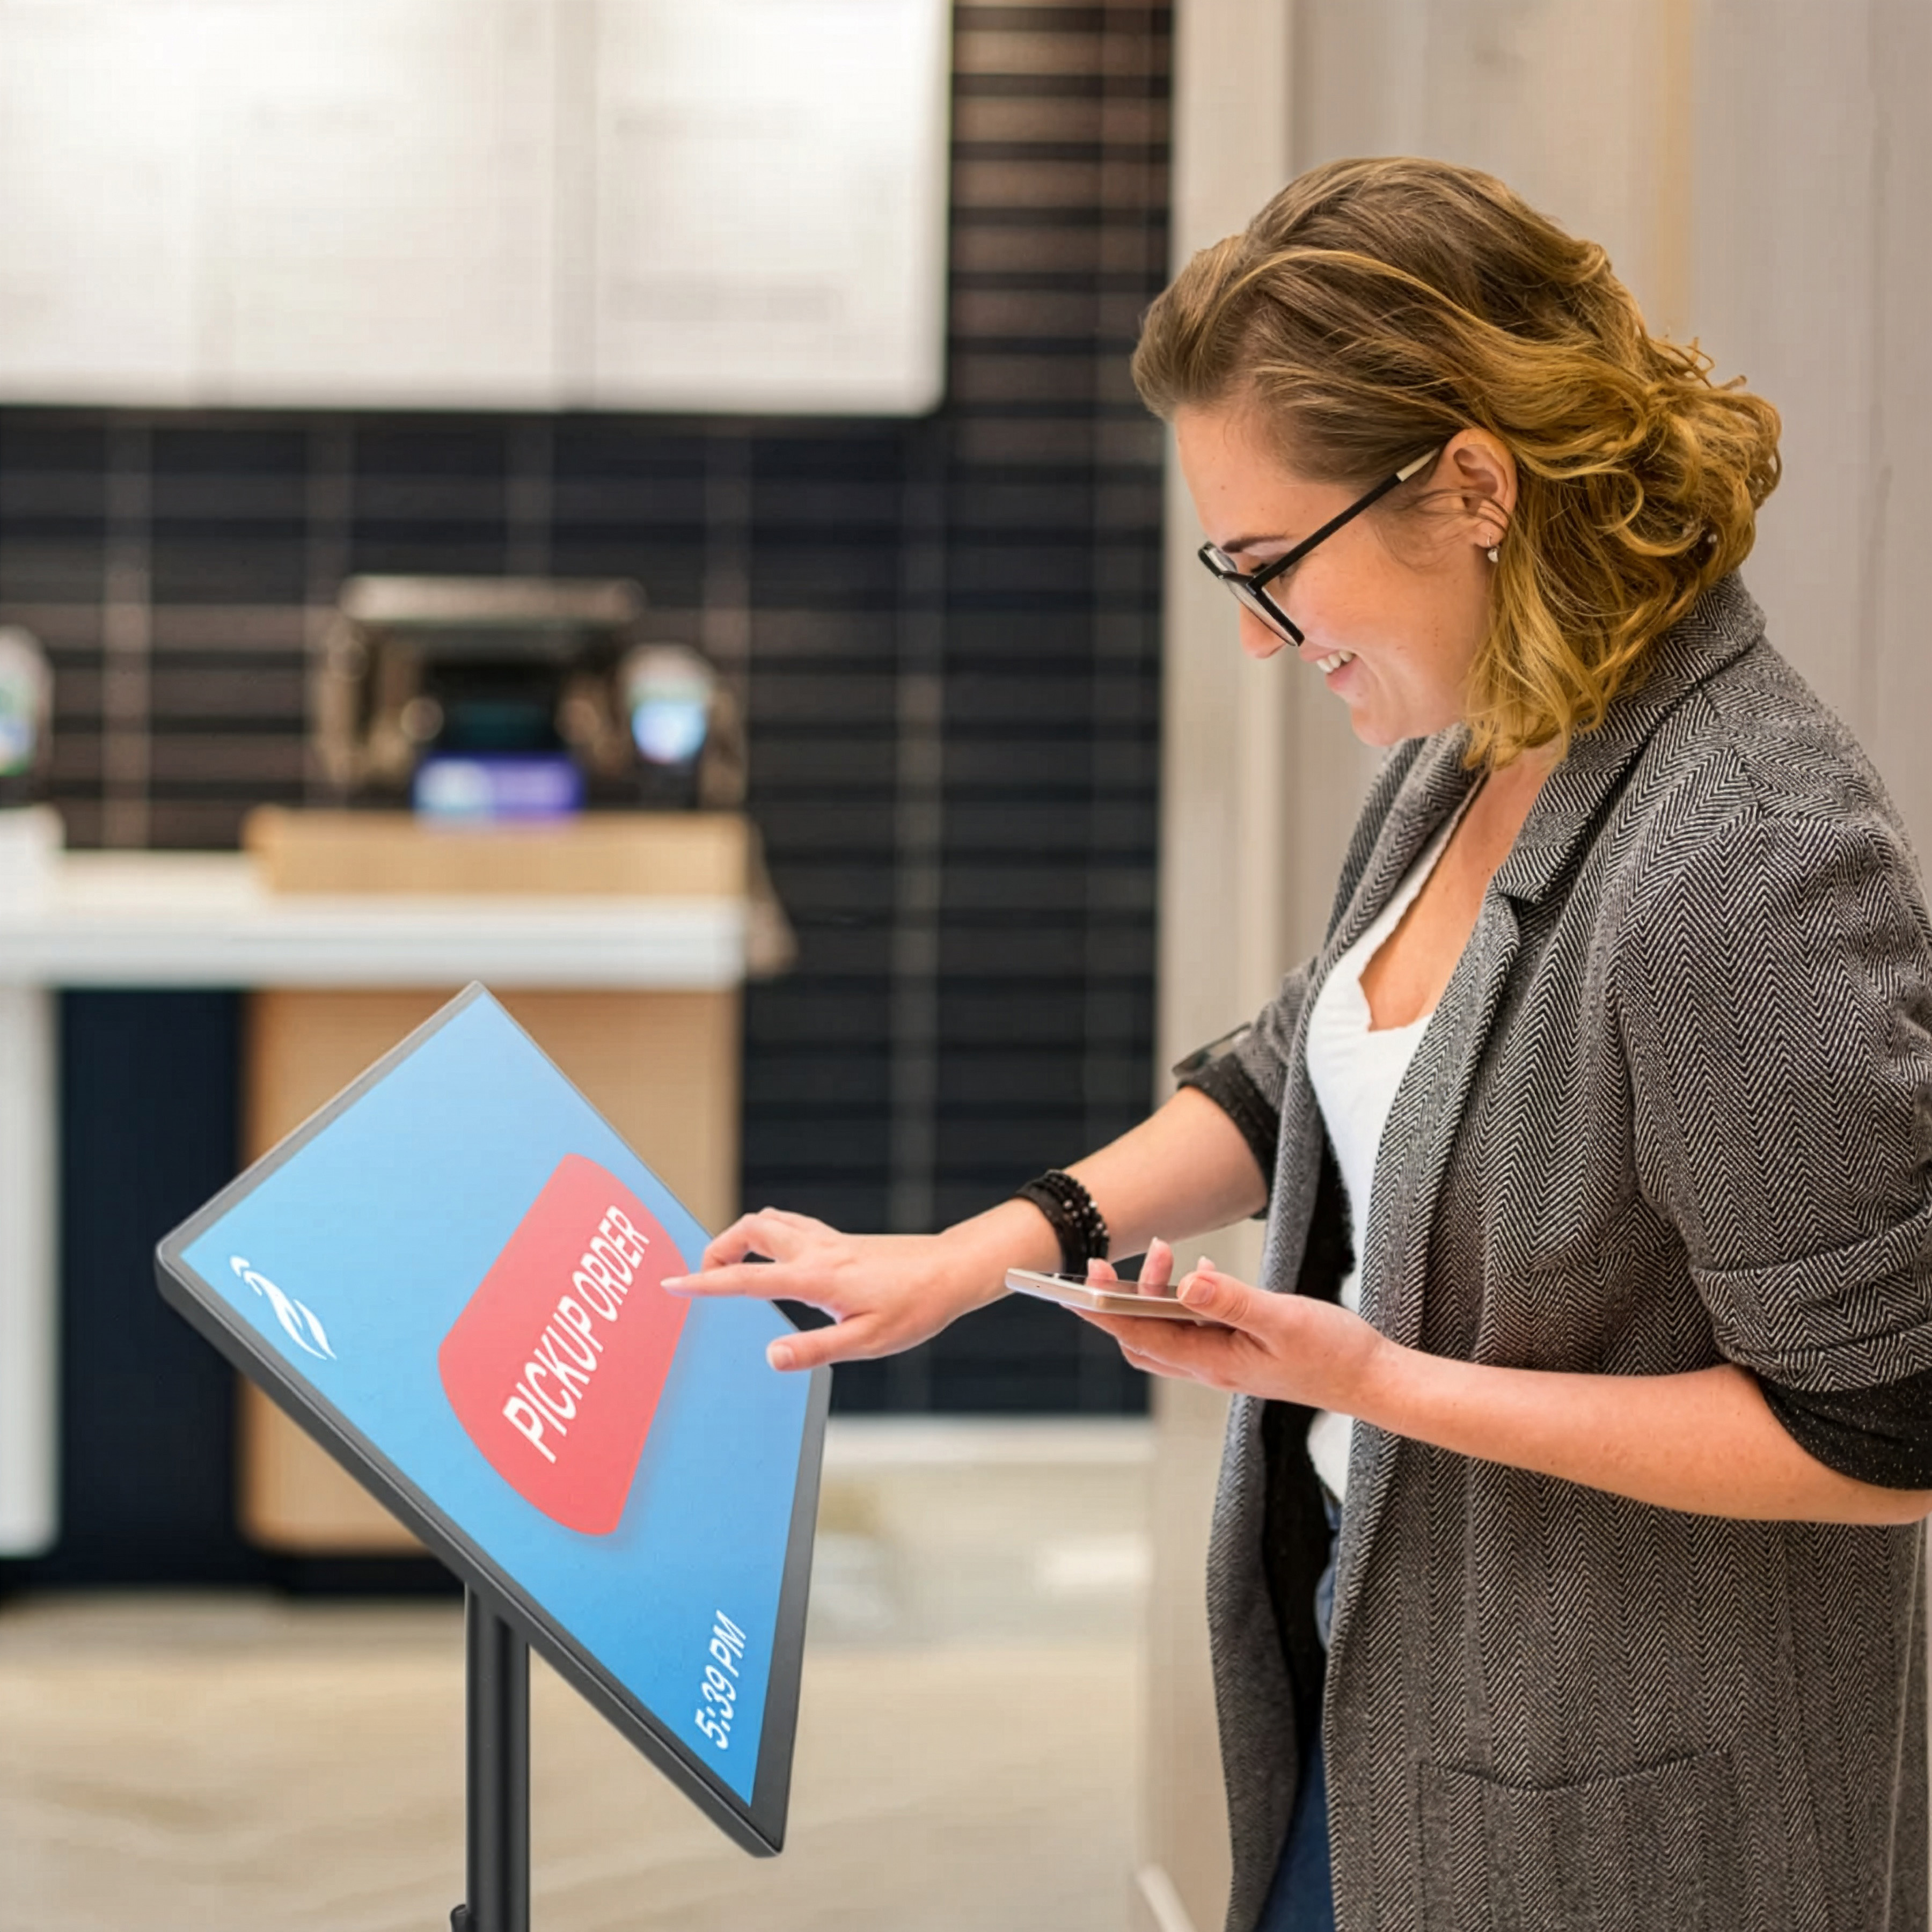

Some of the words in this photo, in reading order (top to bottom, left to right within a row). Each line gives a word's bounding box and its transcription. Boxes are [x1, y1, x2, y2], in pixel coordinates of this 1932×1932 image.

[502, 1295, 604, 1463] PICKUP
[572, 1205, 649, 1321] ORDER
[709, 1609, 747, 1678] PM
[694, 1665, 737, 1750] 5:39
